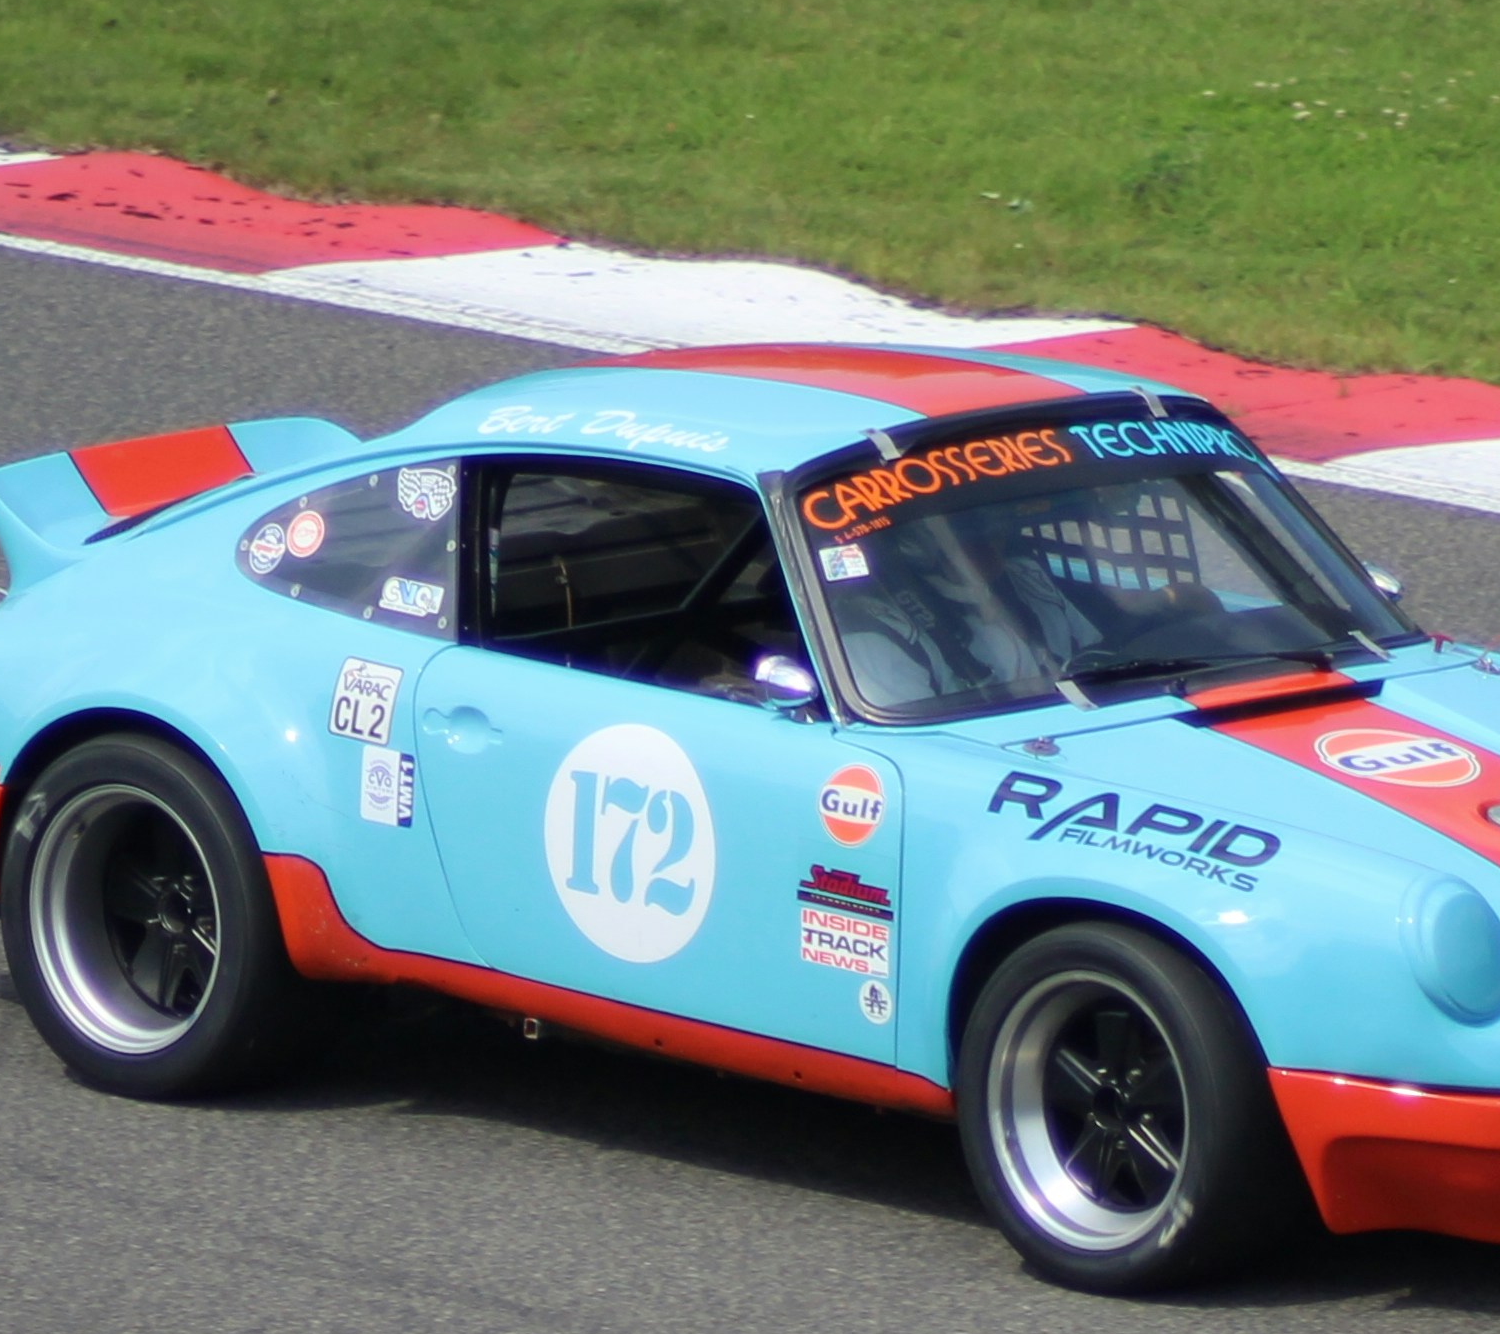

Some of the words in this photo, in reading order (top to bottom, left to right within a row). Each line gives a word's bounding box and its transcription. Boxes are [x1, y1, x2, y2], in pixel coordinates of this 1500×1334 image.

[477, 405, 577, 435] Bert
[579, 410, 731, 452] Dupuis
[803, 428, 1072, 531] CARROSSERIES
[1068, 420, 1257, 463] TECHNIPRO
[343, 672, 392, 702] VARAC
[1336, 740, 1458, 774] Gulf
[398, 760, 414, 819] VMT1
[821, 788, 882, 821] Gulf
[986, 770, 1282, 868] RAPID
[565, 770, 696, 917] 172
[1057, 827, 1259, 893] FILMWORKS
[799, 863, 892, 908] Stadium
[802, 909, 888, 942] INSIDE
[802, 927, 887, 962] TRACK
[801, 947, 870, 974] NEWS
